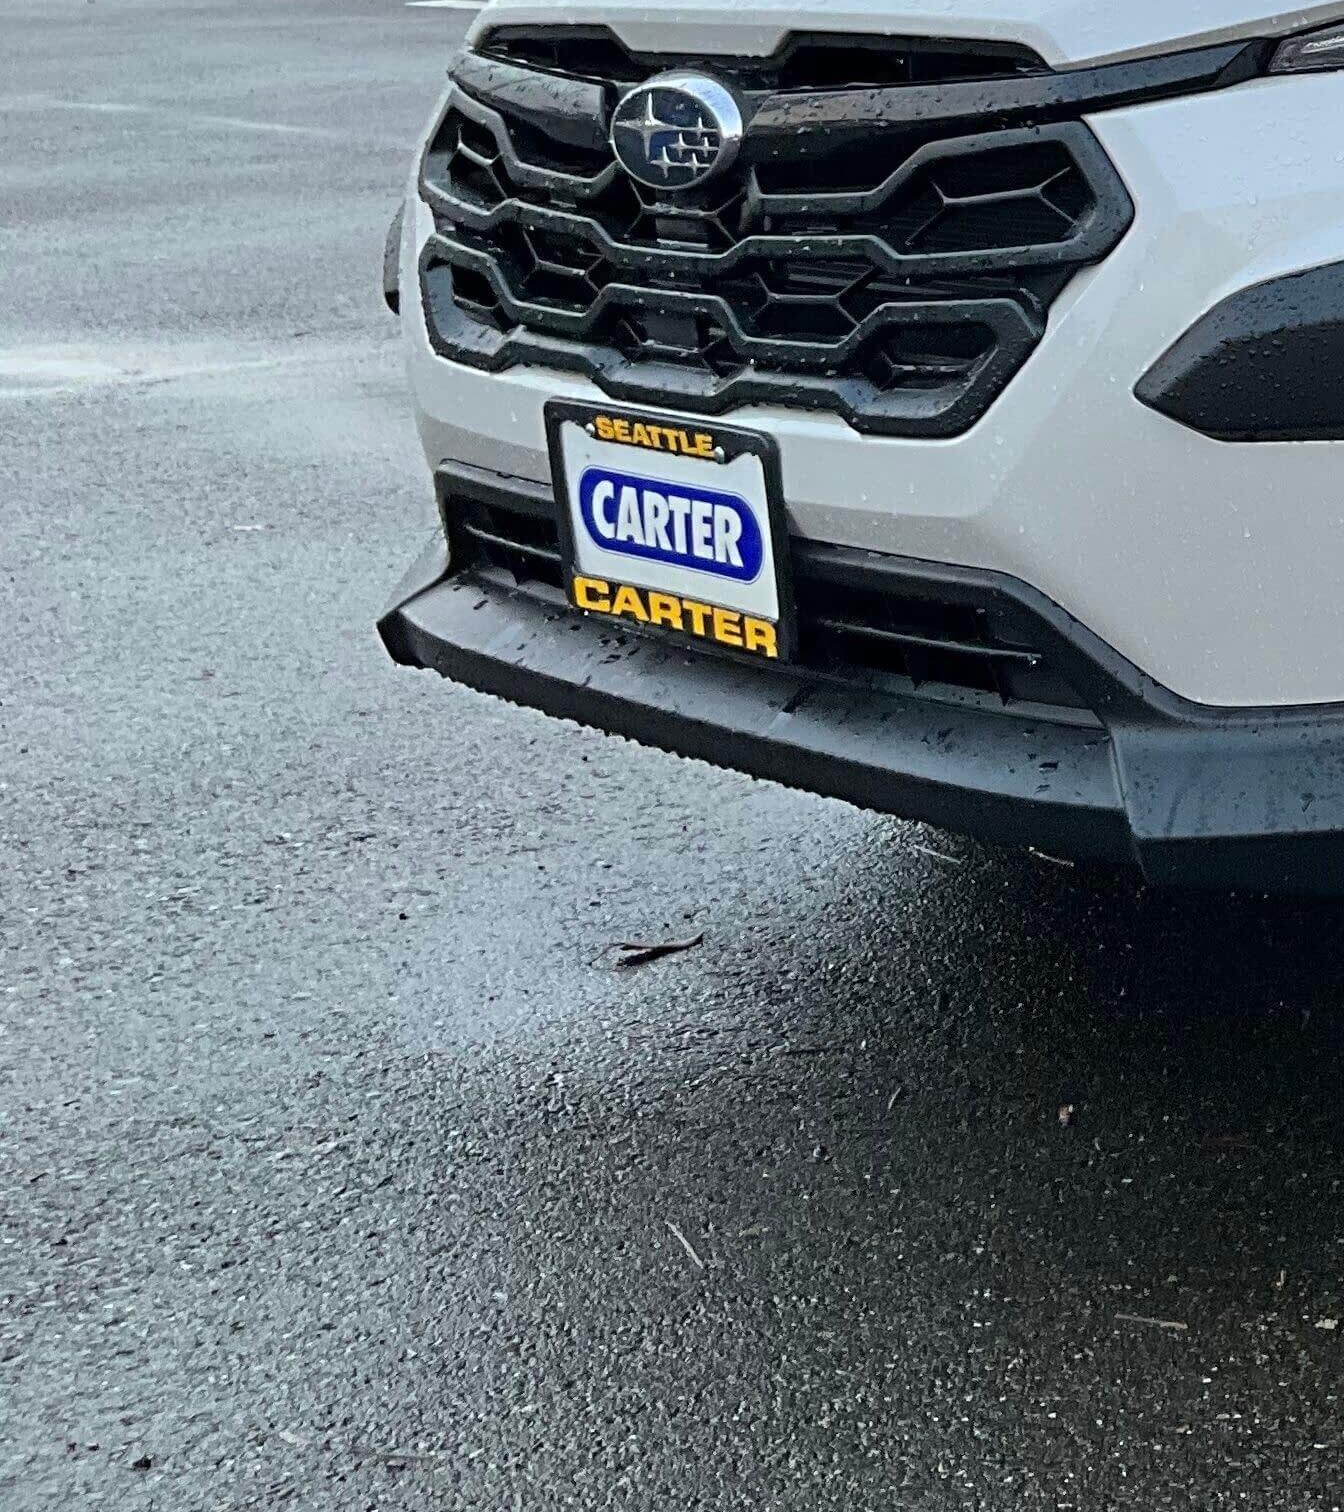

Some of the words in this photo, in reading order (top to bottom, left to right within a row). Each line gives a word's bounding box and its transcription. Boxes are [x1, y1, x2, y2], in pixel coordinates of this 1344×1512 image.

[595, 415, 715, 458] SEATTLE
[592, 480, 743, 567] CARTER
[573, 576, 778, 657] CARTER
